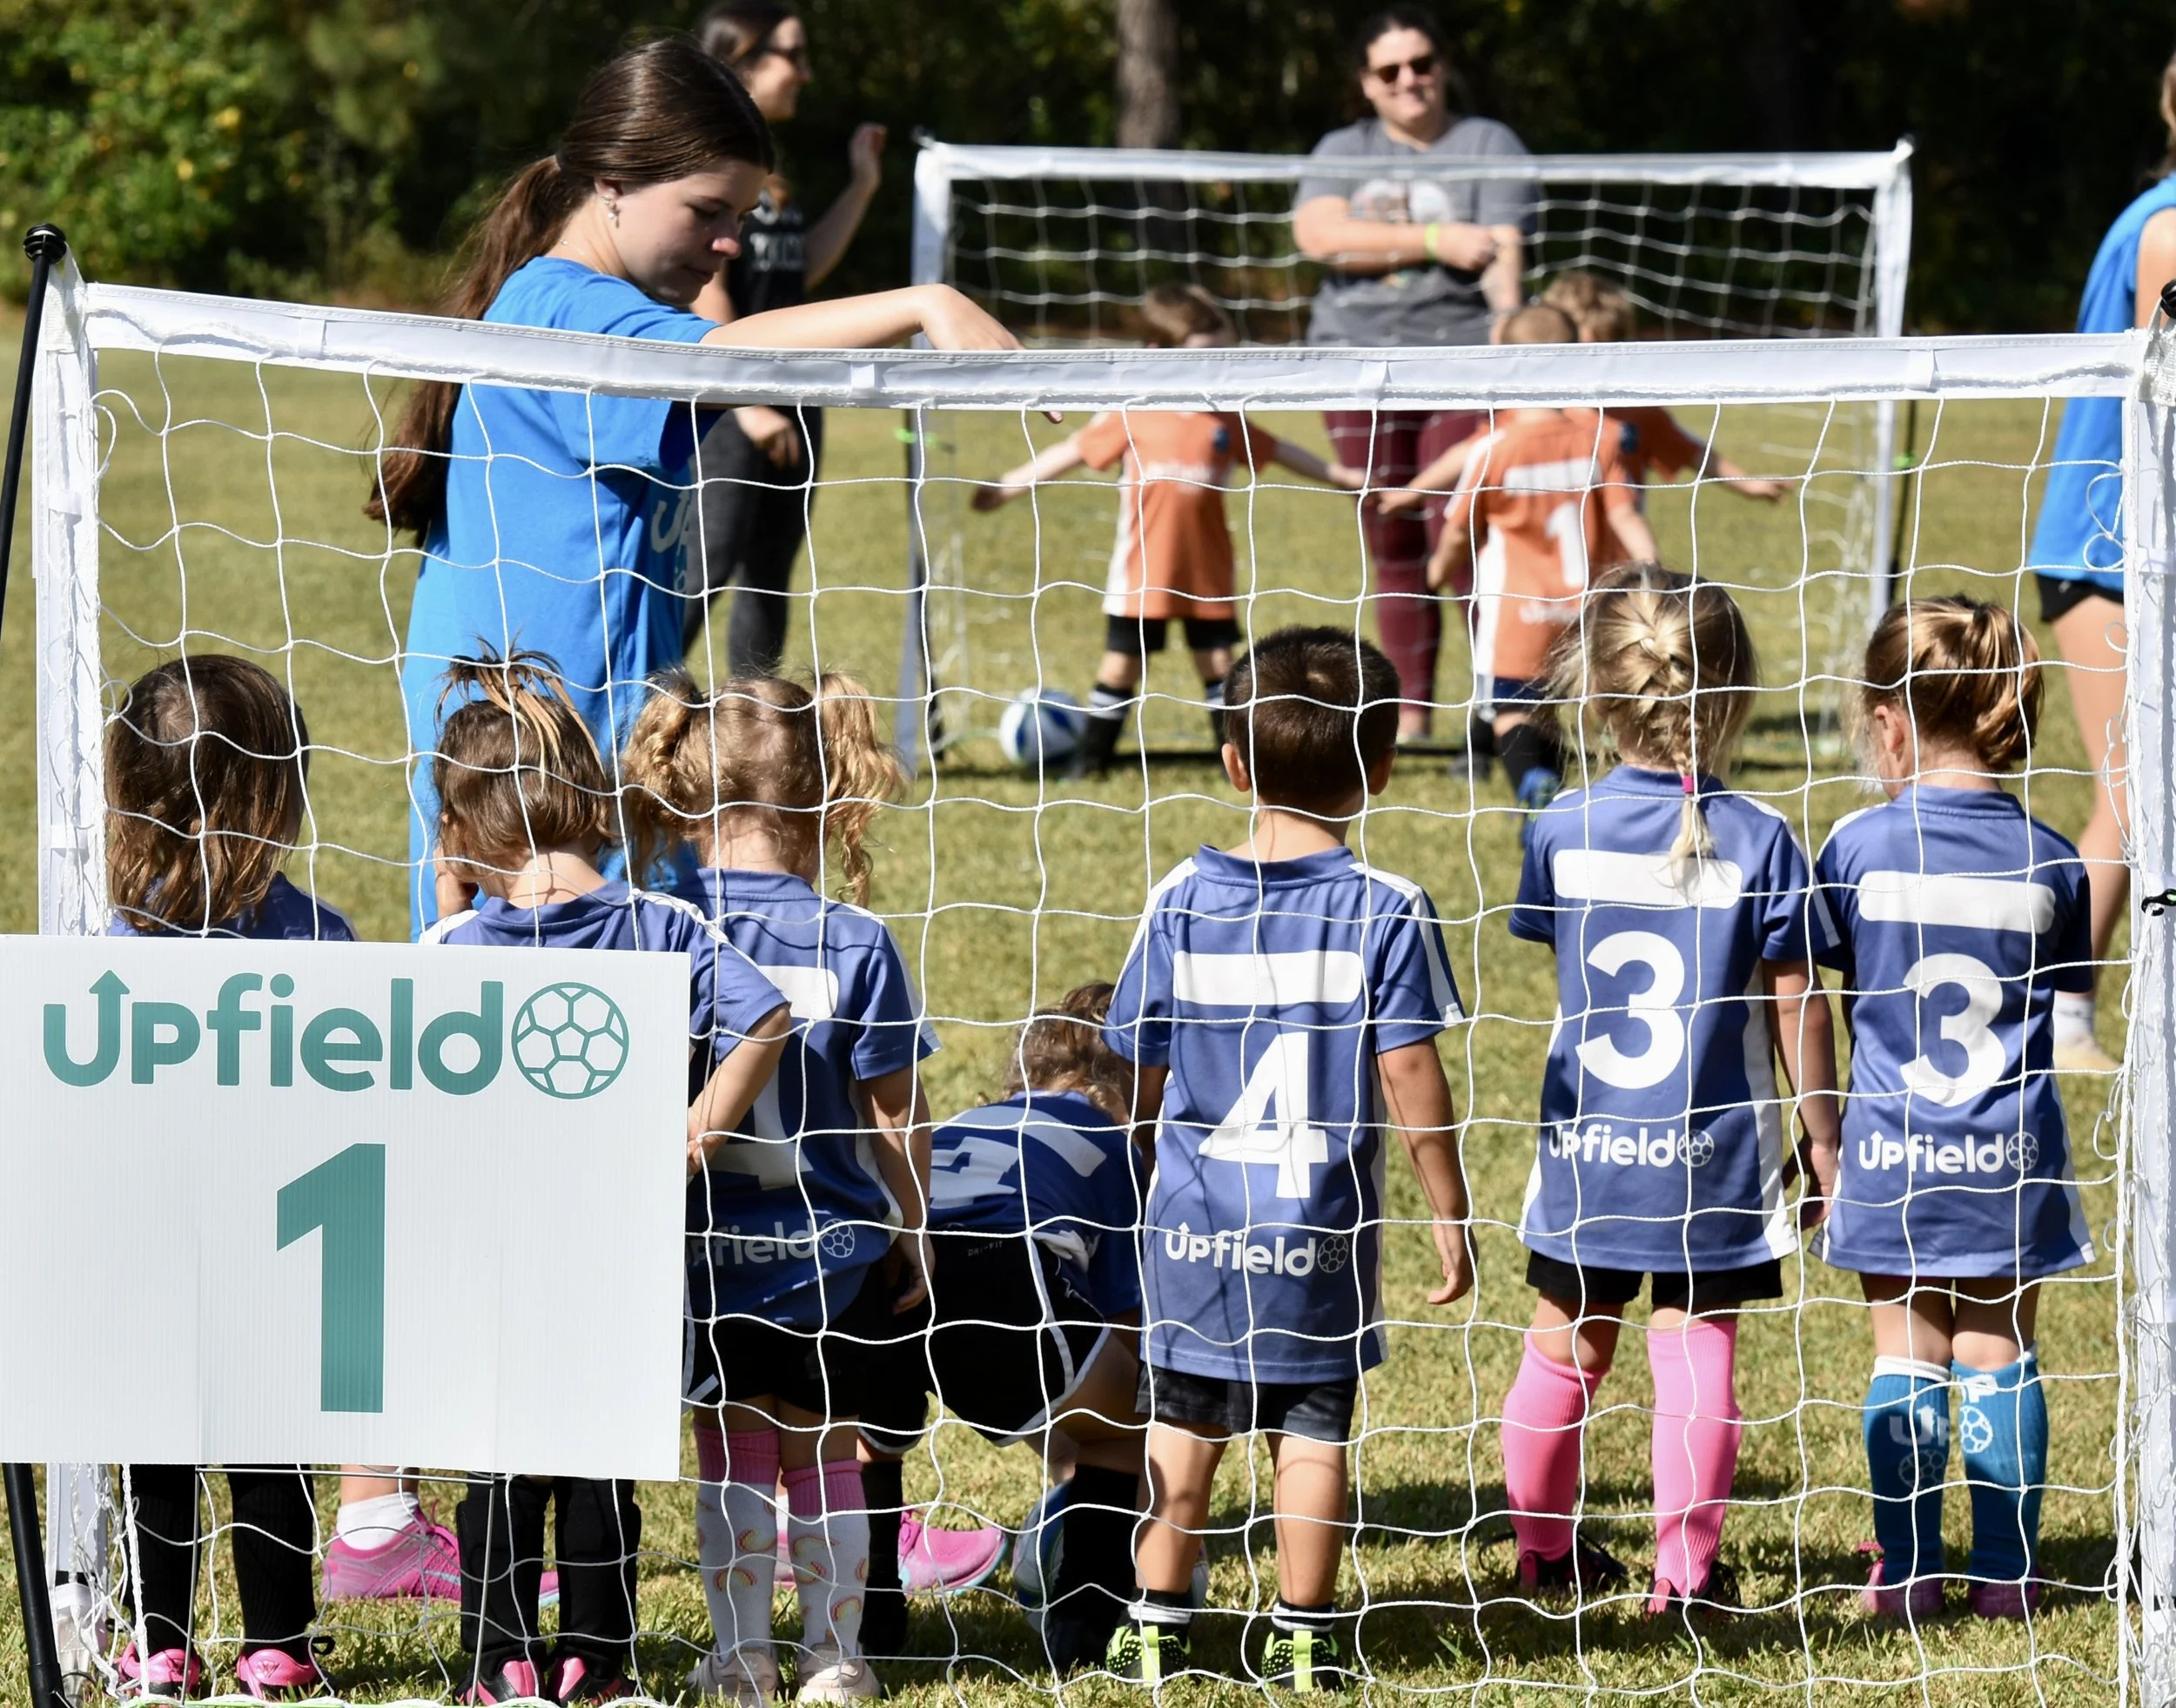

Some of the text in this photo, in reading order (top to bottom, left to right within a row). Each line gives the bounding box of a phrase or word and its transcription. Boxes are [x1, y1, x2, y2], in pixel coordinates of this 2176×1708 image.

[1545, 501, 1585, 588] 1
[1575, 931, 1685, 1089] 3
[1900, 952, 2005, 1107] 3
[1199, 1032, 1329, 1199] 4
[277, 1143, 386, 1413] 1
